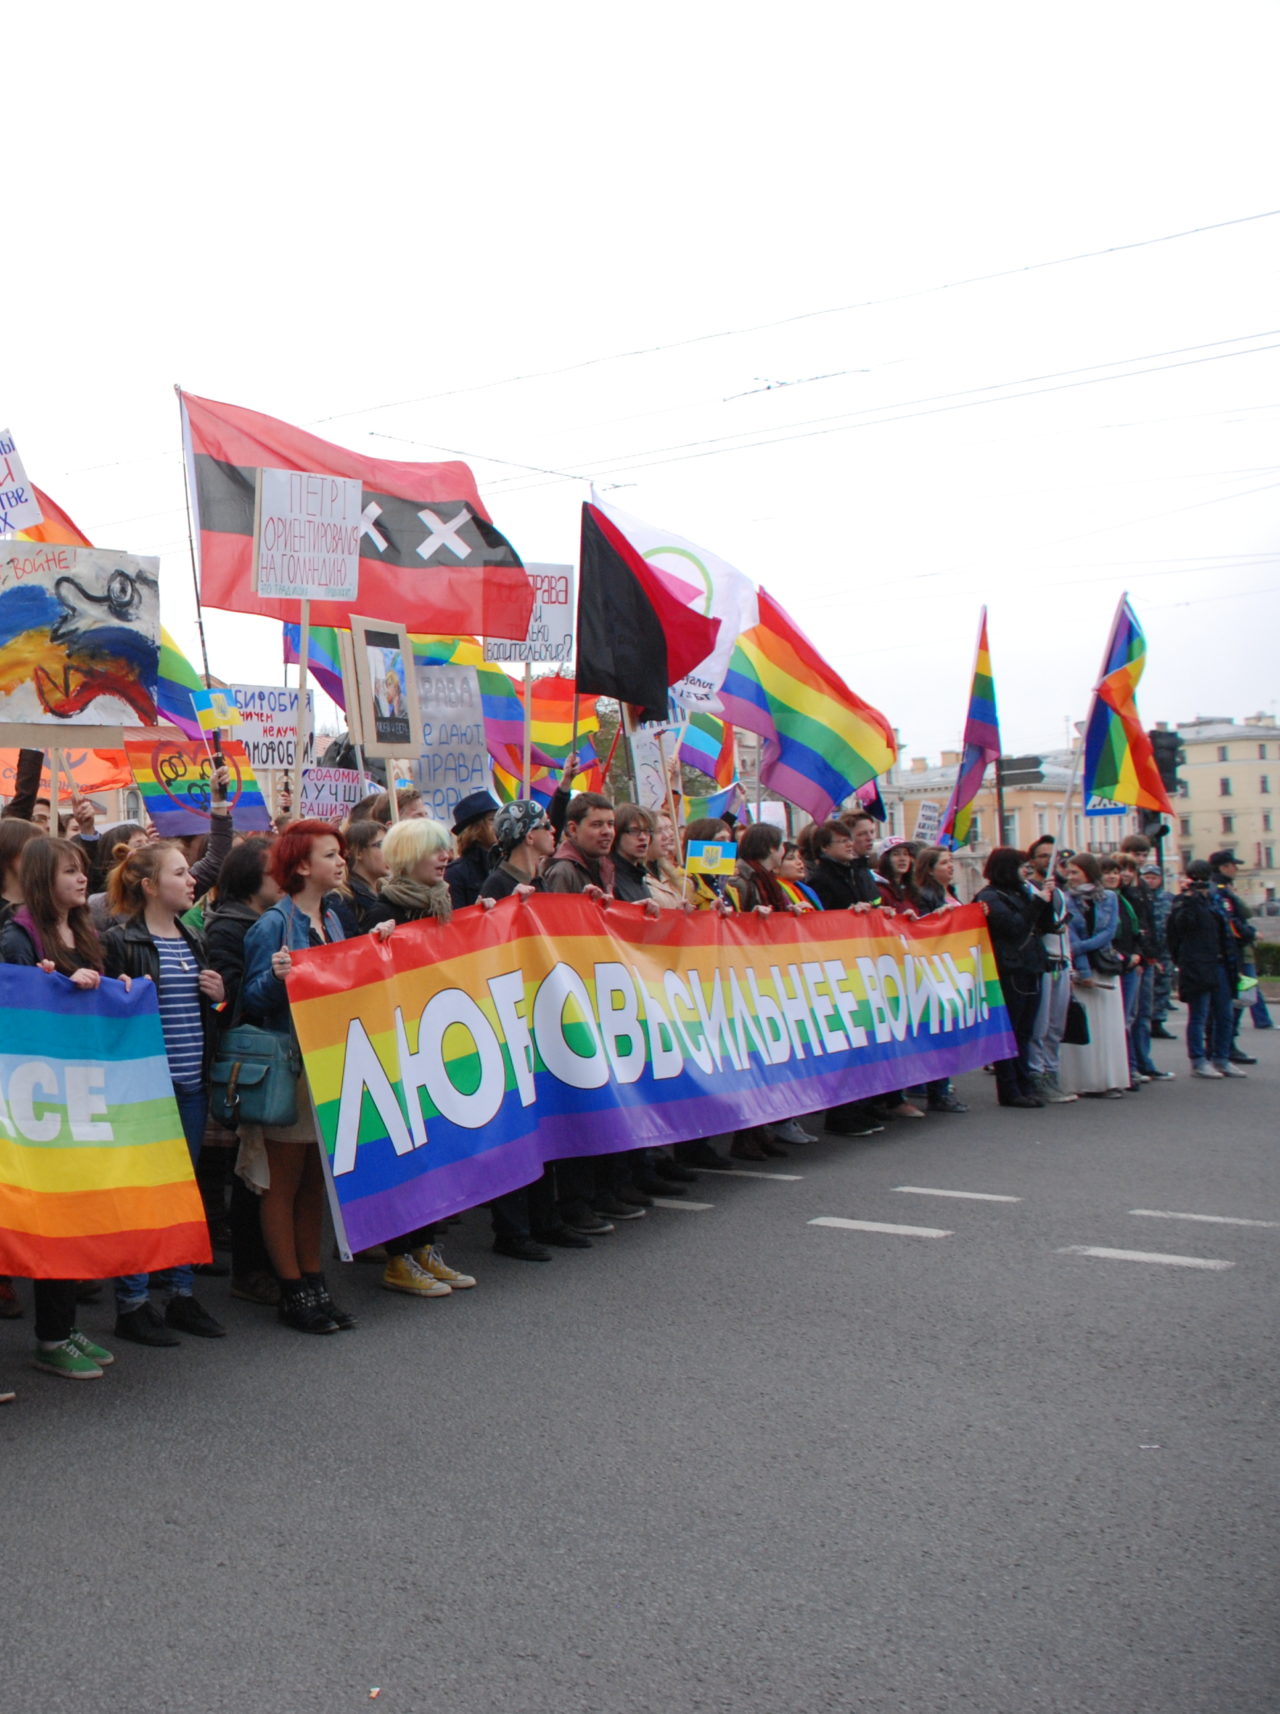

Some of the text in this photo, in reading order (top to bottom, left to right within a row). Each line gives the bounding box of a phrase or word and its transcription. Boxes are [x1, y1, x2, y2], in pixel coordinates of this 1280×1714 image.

[290, 473, 339, 518] ПЕТР
[420, 676, 473, 708] РАВА
[333, 933, 991, 1178] ЛЮБОВЬ СИЛЬНЕЕ ВОЙНЫ!
